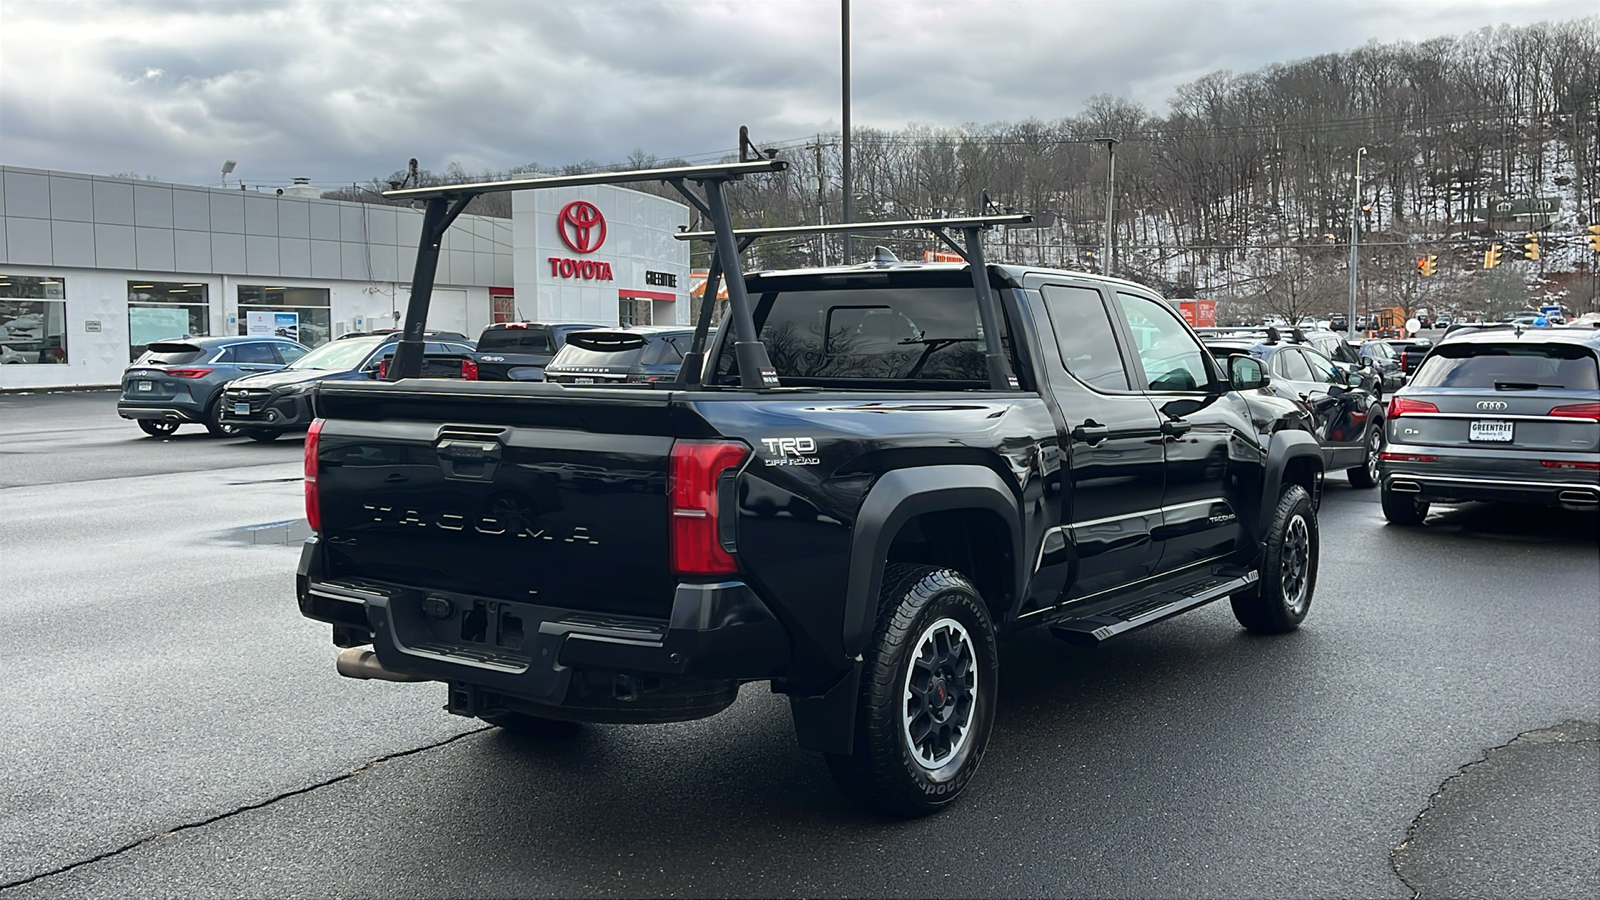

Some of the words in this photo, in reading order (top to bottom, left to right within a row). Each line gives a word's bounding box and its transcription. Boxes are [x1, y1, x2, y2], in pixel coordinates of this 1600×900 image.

[548, 257, 614, 281] TOYOTA
[645, 270, 677, 288] GREENTREE
[1472, 423, 1512, 432] GREENTREE
[760, 437, 817, 458] TRD
[764, 458, 788, 467] OFF
[789, 457, 821, 466] ROAD
[363, 503, 599, 545] TACOMA
[1209, 513, 1236, 523] TACOMA
